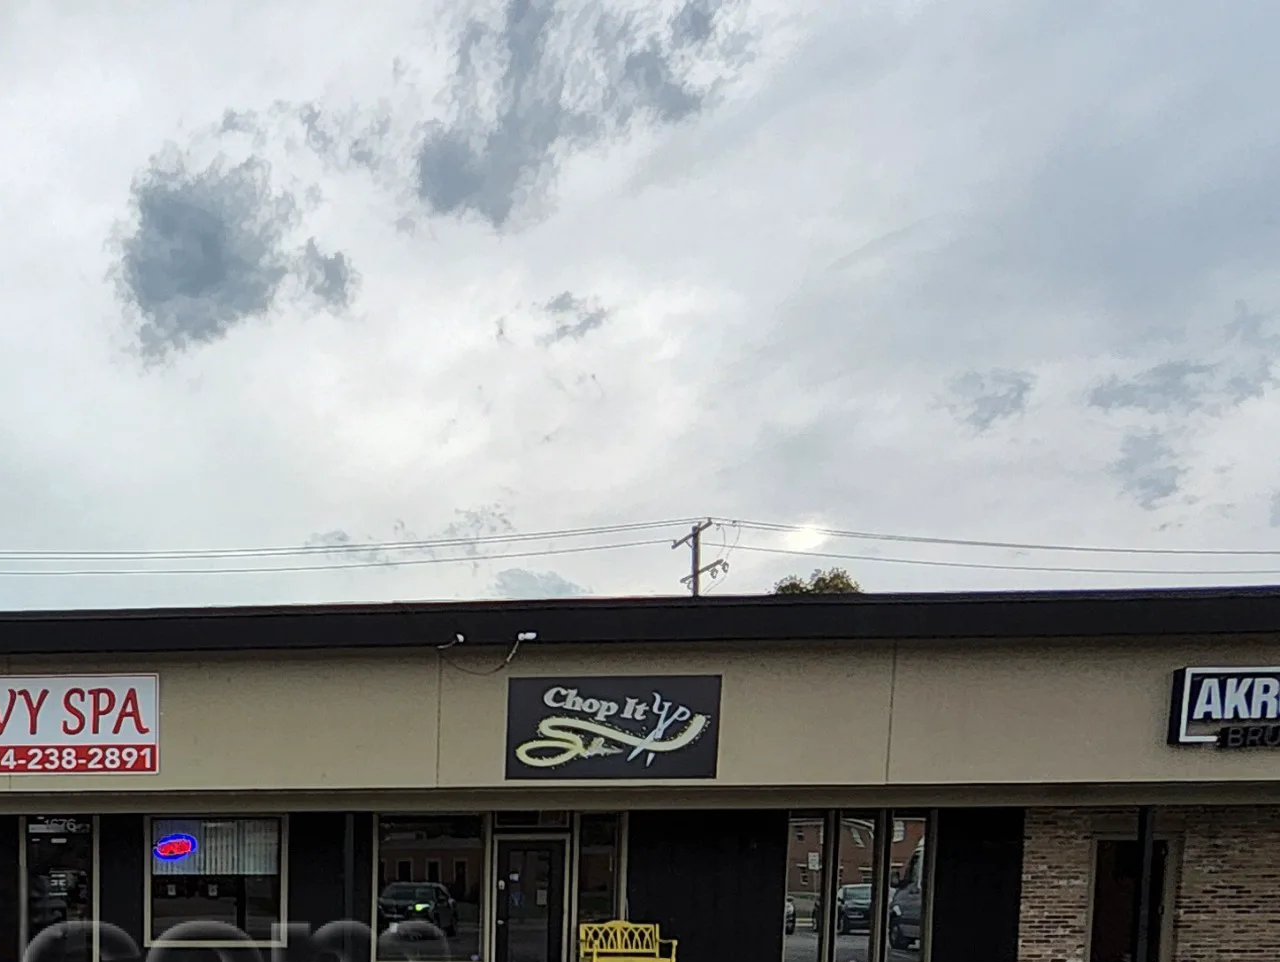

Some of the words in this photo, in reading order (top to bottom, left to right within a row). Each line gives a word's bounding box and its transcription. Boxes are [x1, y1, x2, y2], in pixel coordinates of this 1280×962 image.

[62, 687, 150, 736] SPA
[543, 687, 619, 721] Chop
[620, 697, 650, 721] It
[1192, 677, 1280, 720] AKR
